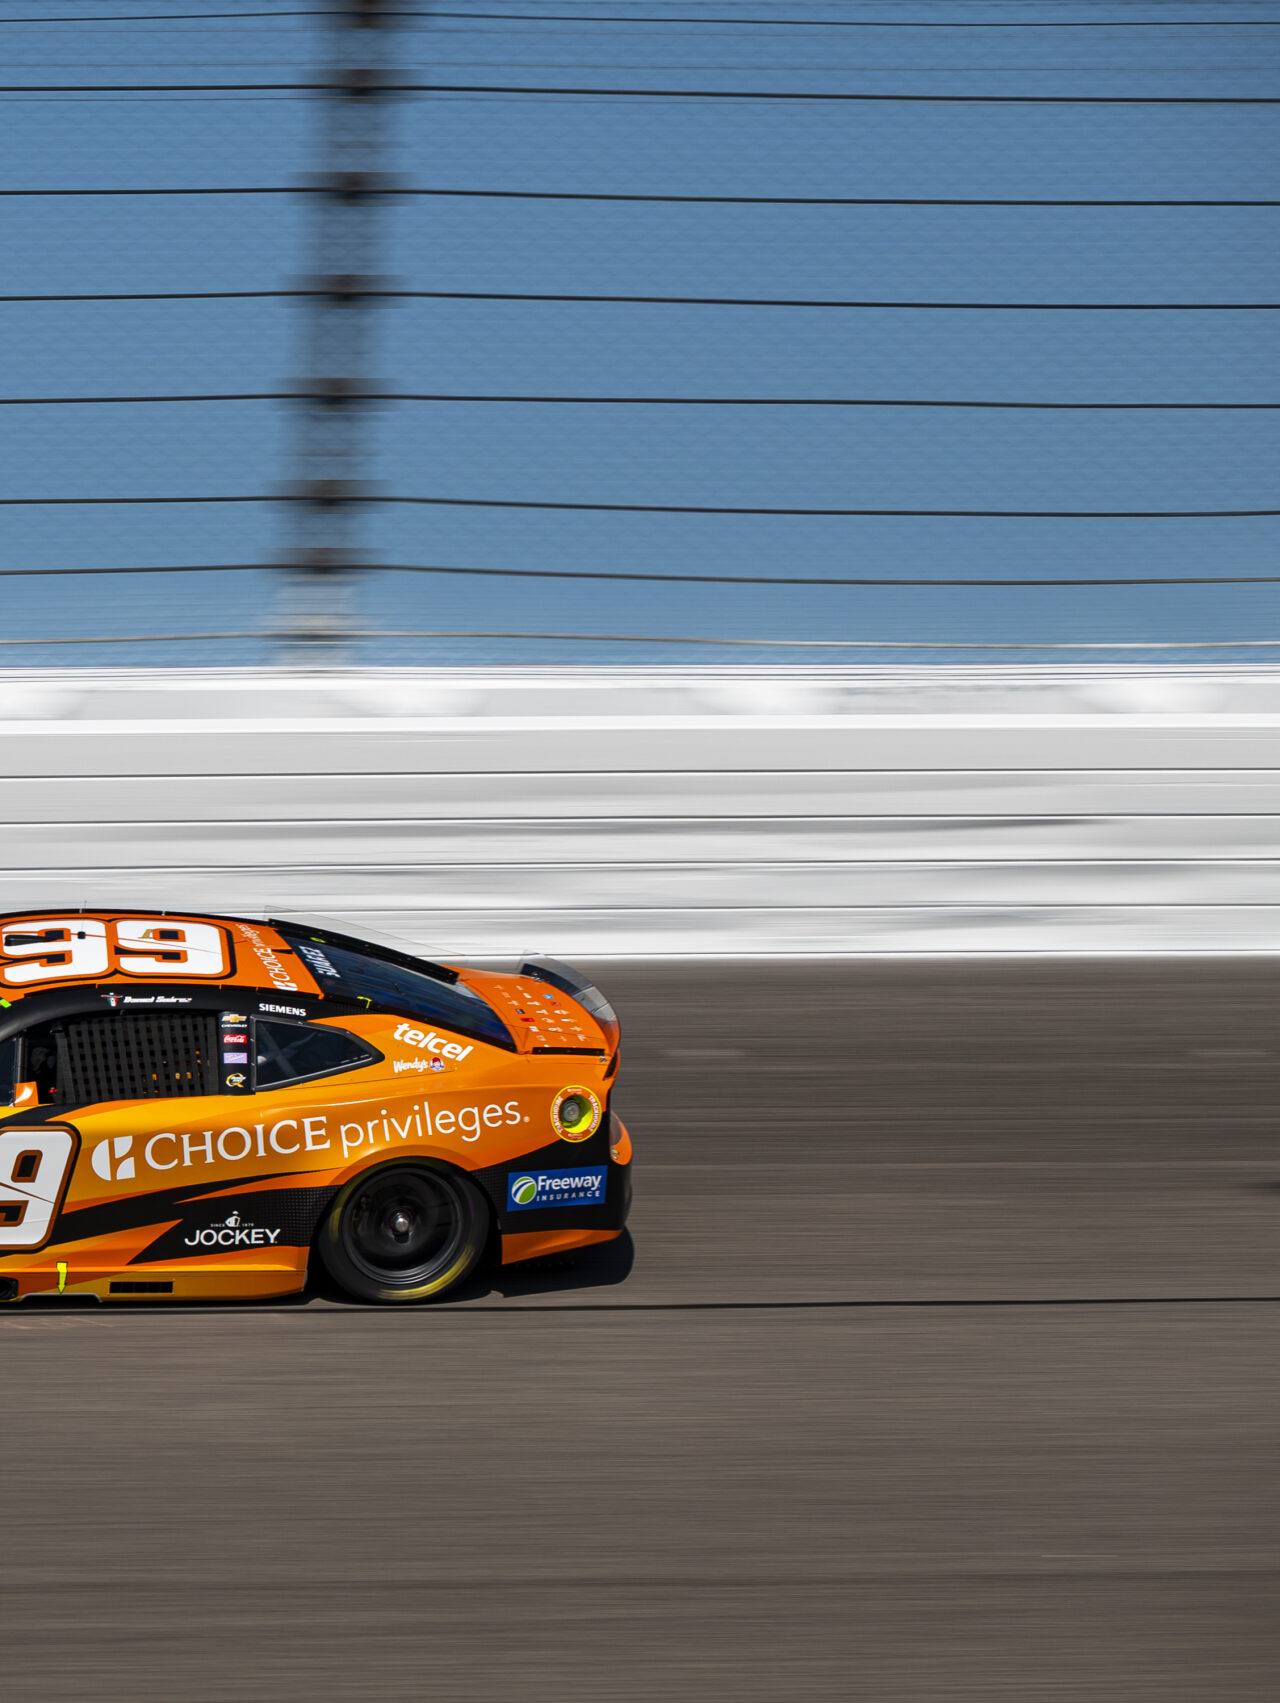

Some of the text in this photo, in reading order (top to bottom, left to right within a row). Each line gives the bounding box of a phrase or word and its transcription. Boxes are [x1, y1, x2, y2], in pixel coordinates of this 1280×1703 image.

[258, 1003, 307, 1017] SIEMENS
[393, 1023, 474, 1062] telcel
[393, 1057, 428, 1074] Wendy's
[144, 1115, 331, 1170] CHOICE
[537, 1175, 602, 1191] Freeway
[536, 1190, 601, 1202] INSURANCE
[184, 1228, 281, 1246] JOCKEY
